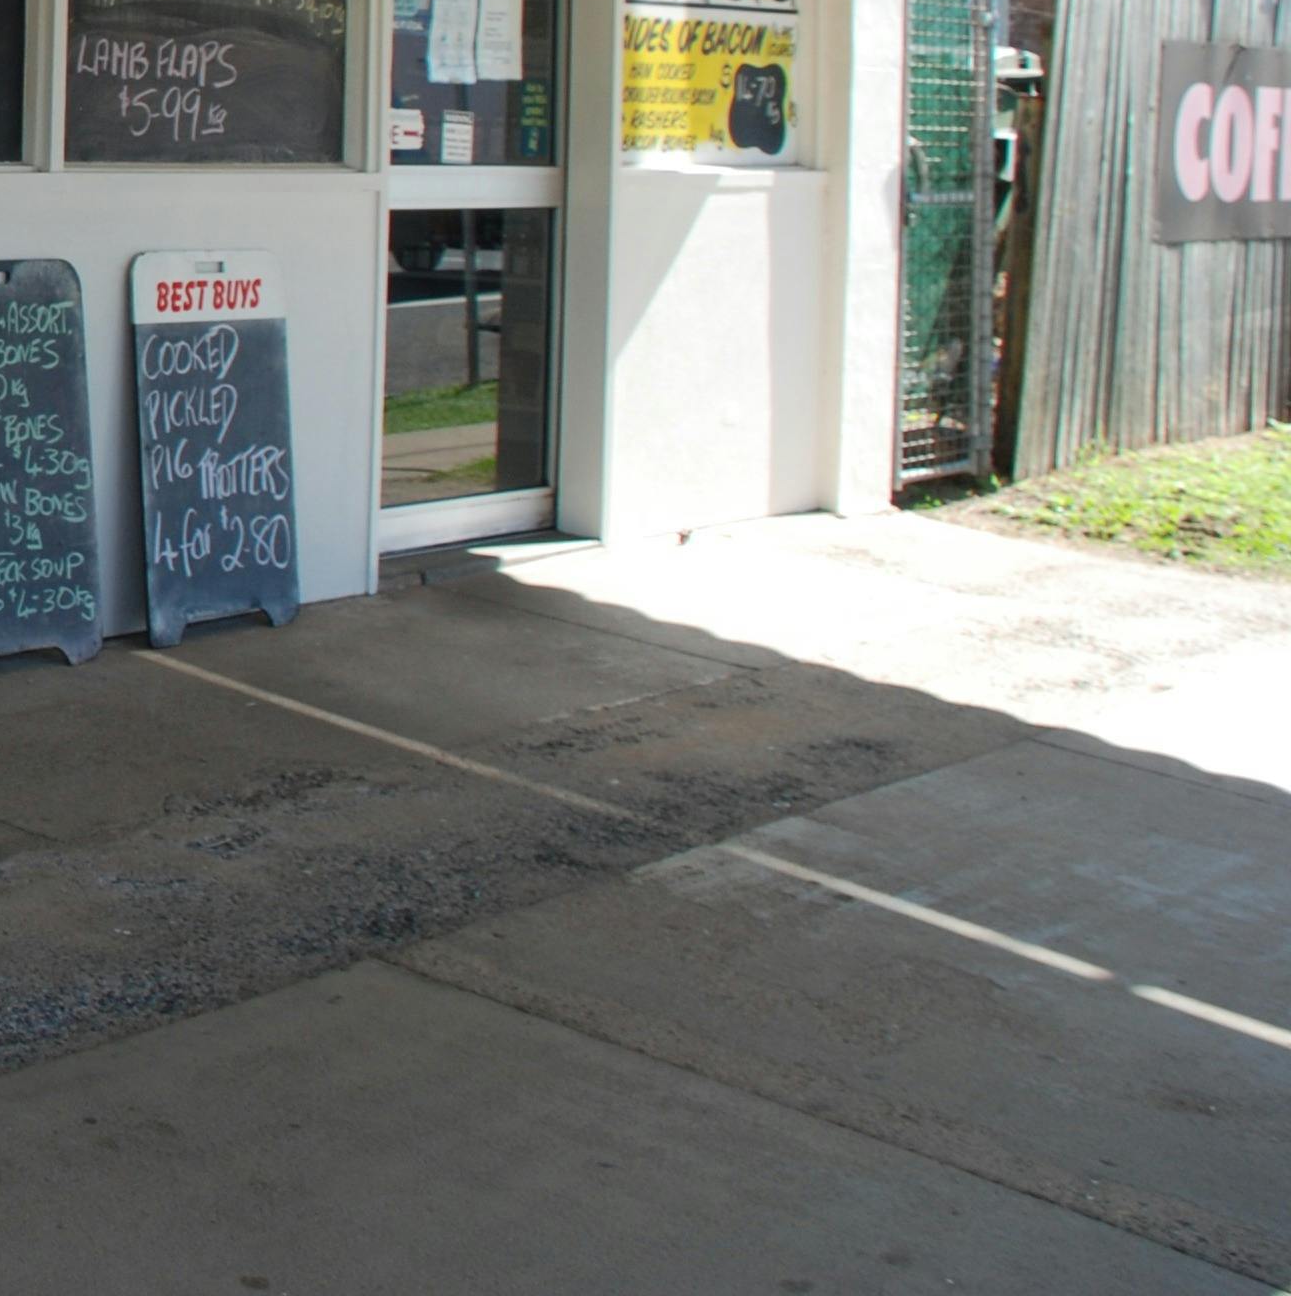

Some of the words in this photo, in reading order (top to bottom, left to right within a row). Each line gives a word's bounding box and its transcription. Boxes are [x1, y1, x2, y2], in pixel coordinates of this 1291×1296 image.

[701, 20, 768, 55] BACON
[77, 35, 150, 81] LAMB
[155, 37, 239, 89] FLAPS
[156, 279, 209, 314] BEST
[212, 277, 262, 311] BUYS
[143, 324, 241, 381] COOKED
[3, 413, 64, 449] BONES
[145, 383, 239, 444] PICKLED
[150, 439, 193, 491] PIG
[197, 444, 291, 501] TROTTERS
[24, 486, 88, 523] BONES
[153, 509, 180, 572] 4
[30, 551, 85, 582] SOUP
